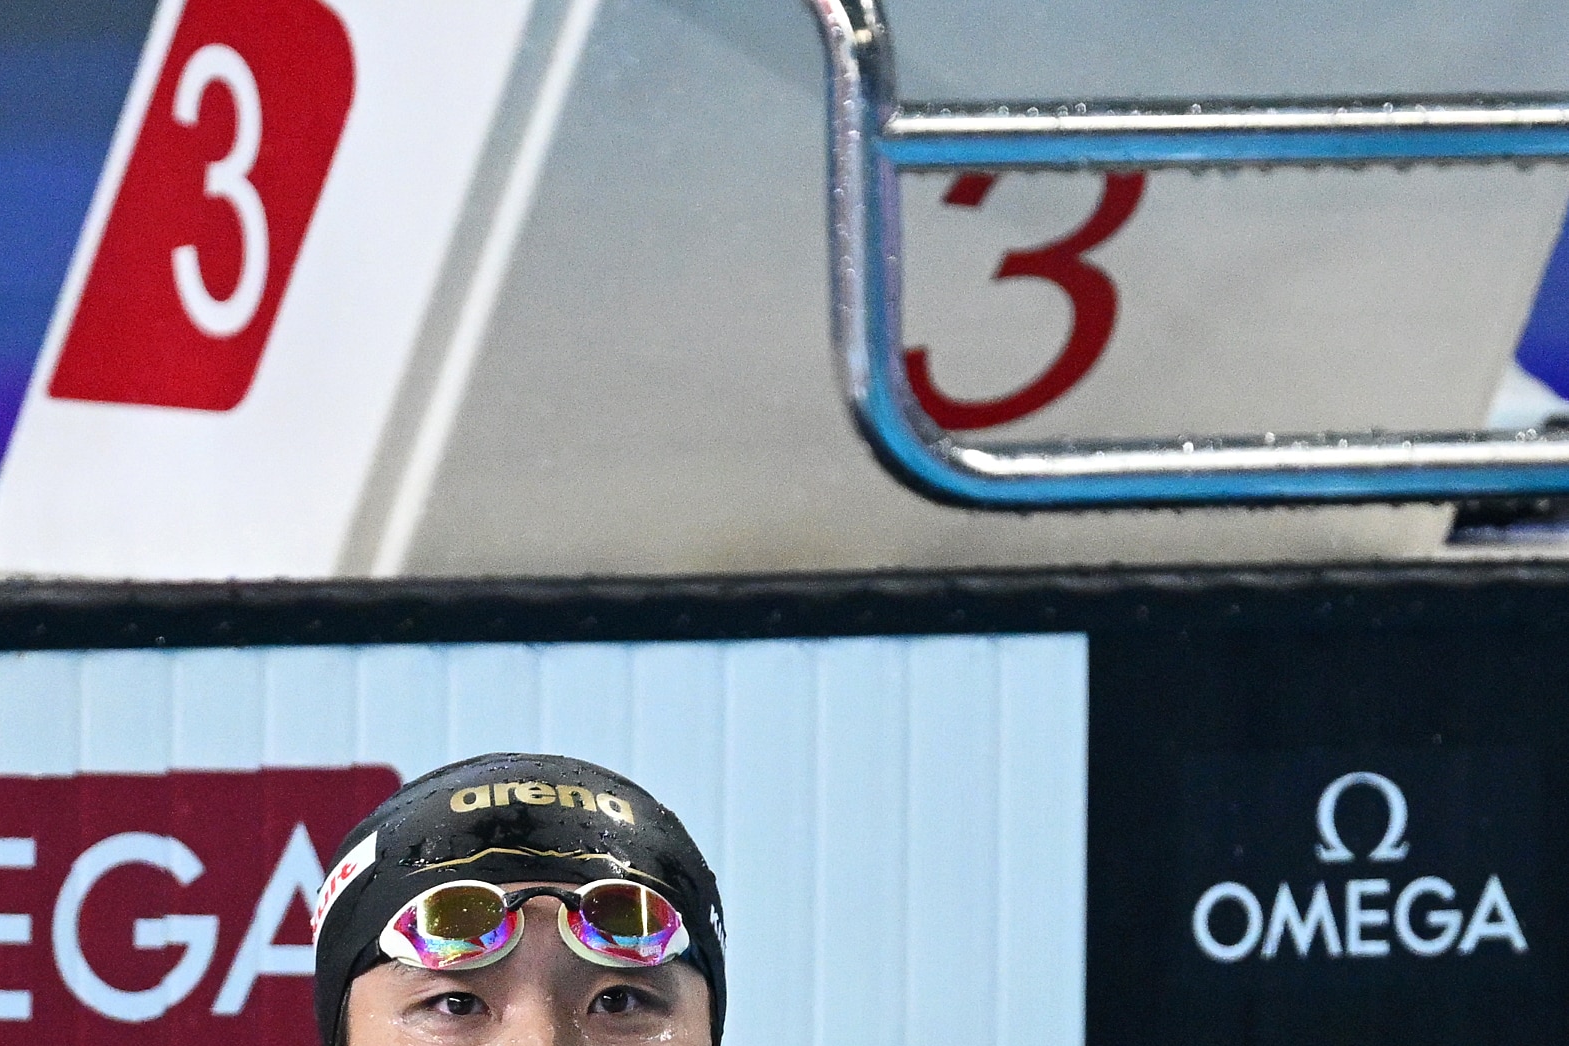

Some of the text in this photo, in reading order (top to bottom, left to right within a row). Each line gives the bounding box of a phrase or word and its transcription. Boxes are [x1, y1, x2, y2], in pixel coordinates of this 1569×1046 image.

[171, 42, 269, 338] 3
[905, 172, 1147, 431] 3
[449, 780, 635, 826] arena
[1192, 873, 1529, 963] OMEGA
